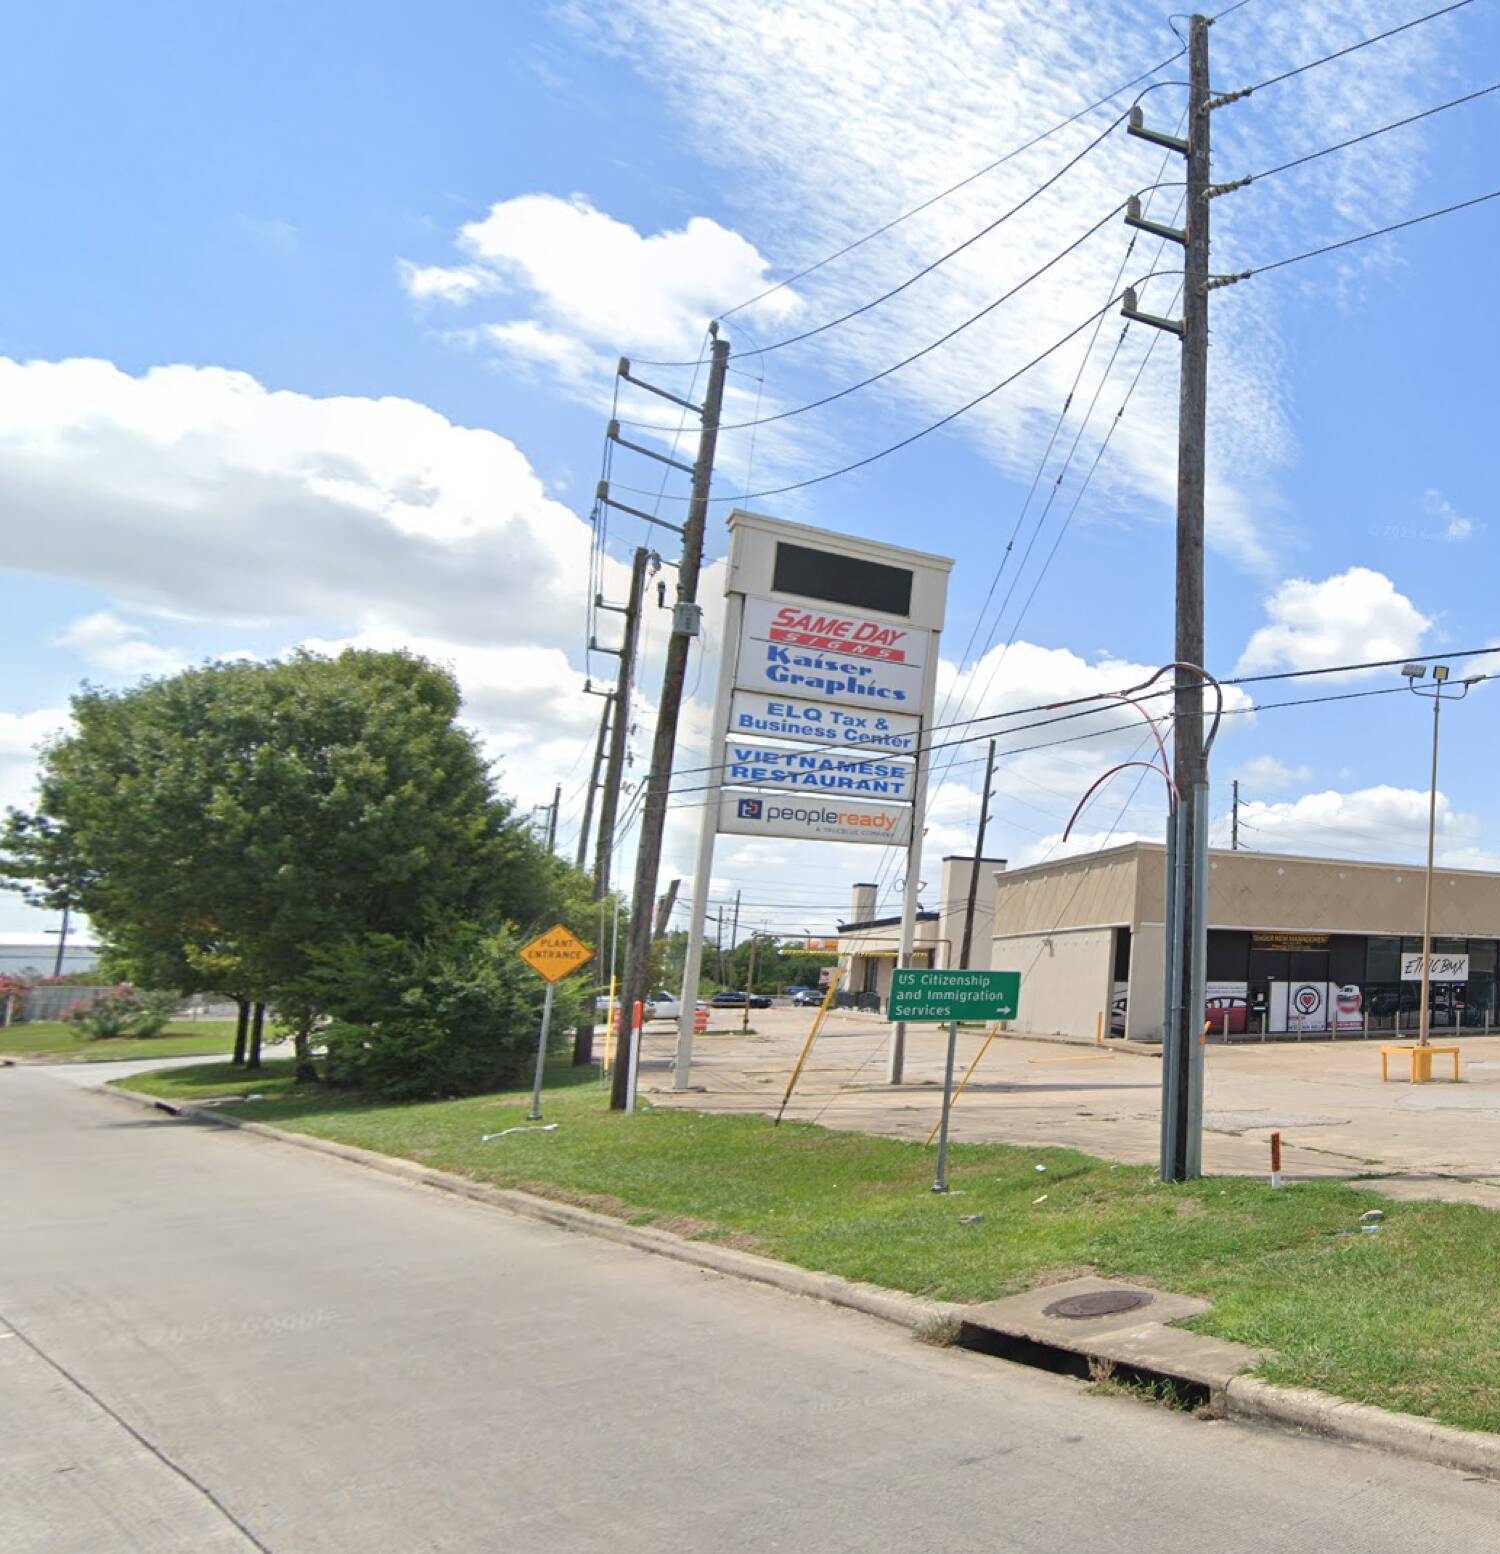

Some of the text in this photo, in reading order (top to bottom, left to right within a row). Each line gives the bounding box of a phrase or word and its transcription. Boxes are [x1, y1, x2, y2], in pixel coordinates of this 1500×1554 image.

[771, 608, 906, 646] SAME DAY
[784, 632, 891, 658] SIGNS
[767, 645, 872, 677] Kaiser
[766, 664, 906, 700] Graphics
[767, 702, 888, 730] ELQ Tax &
[739, 714, 912, 749] Business Center
[734, 749, 906, 779] VIETNAMESE
[731, 766, 904, 794] RESTAURANT
[767, 806, 897, 832] peopleready
[527, 950, 581, 960] ENTRANCE
[898, 974, 991, 988] US Citizenship
[895, 1004, 951, 1016] Services
[896, 989, 1004, 1003] and Immigration
